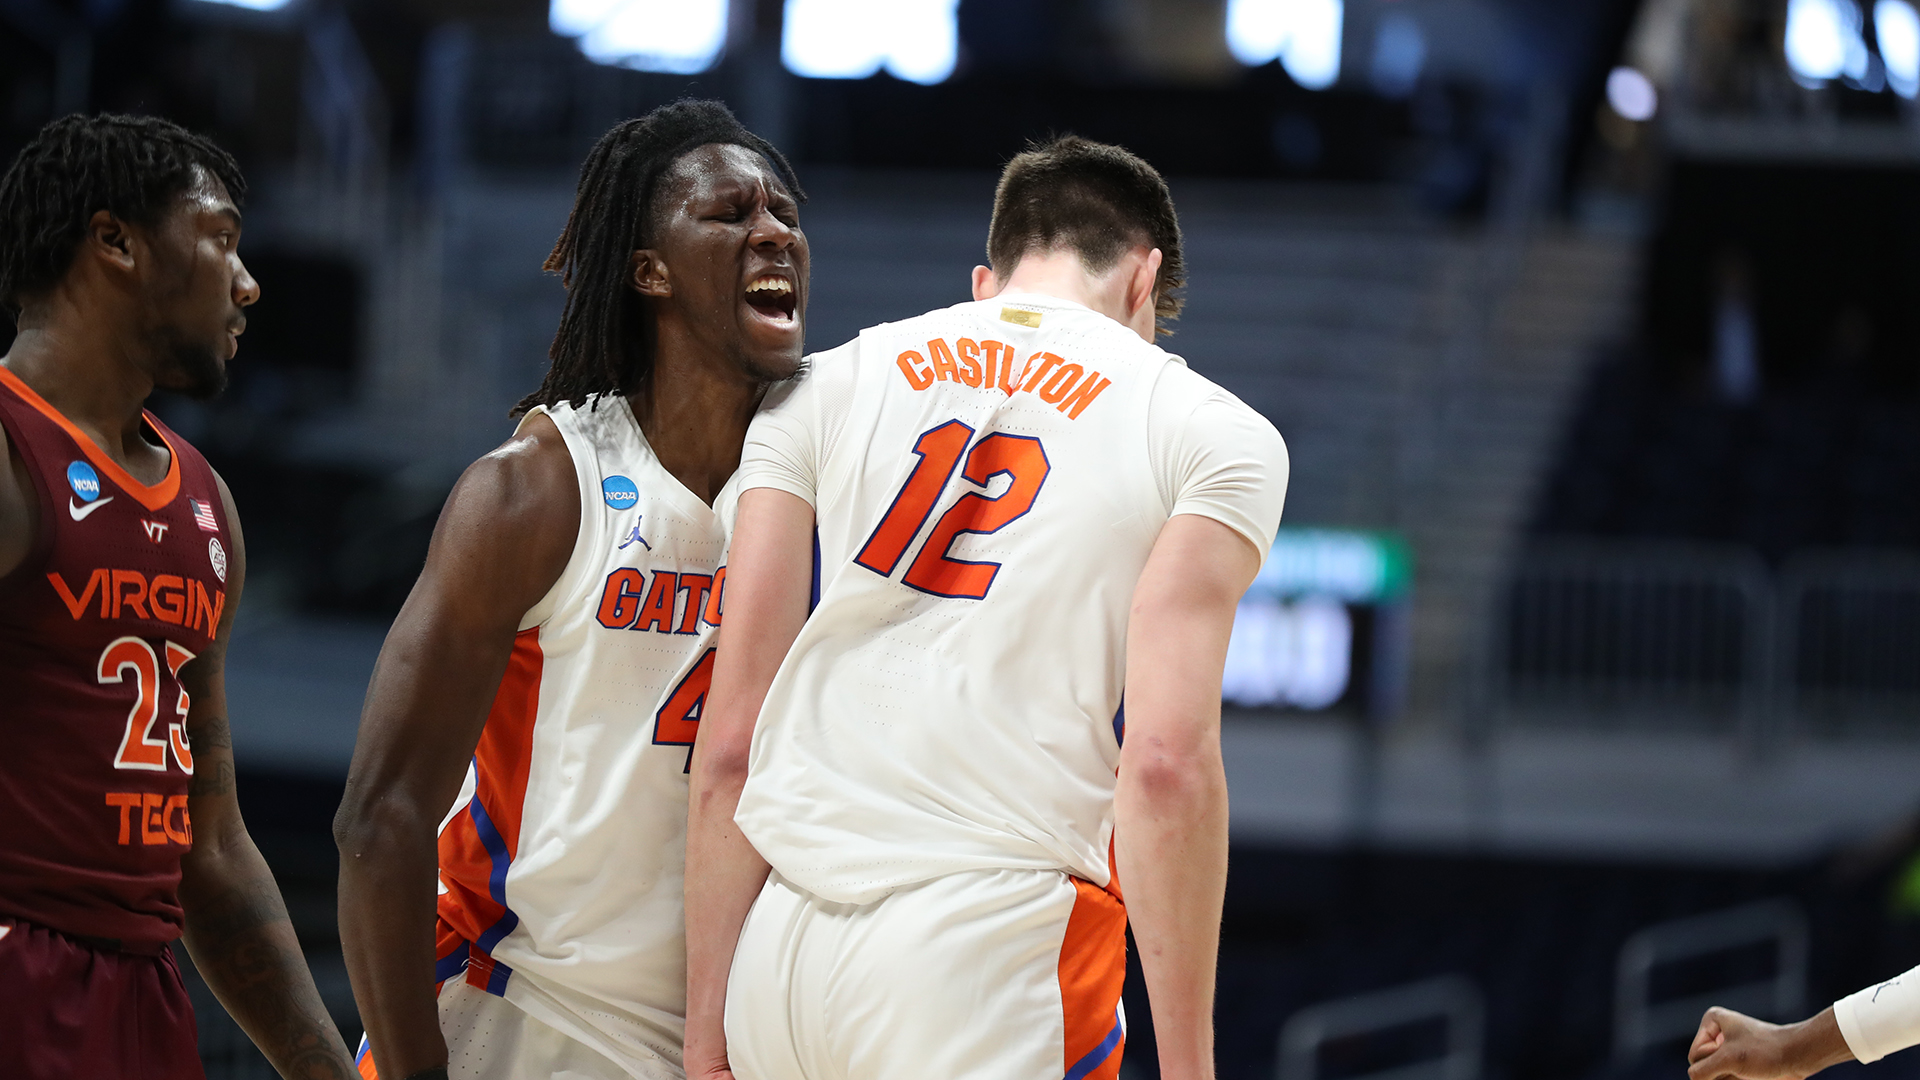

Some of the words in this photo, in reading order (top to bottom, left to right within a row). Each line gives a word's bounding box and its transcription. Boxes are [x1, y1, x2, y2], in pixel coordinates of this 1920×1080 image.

[73, 479, 99, 493] NCAA
[605, 491, 637, 501] NCAA
[852, 418, 1051, 601] 12
[140, 519, 169, 544] VT
[651, 647, 718, 775] 4
